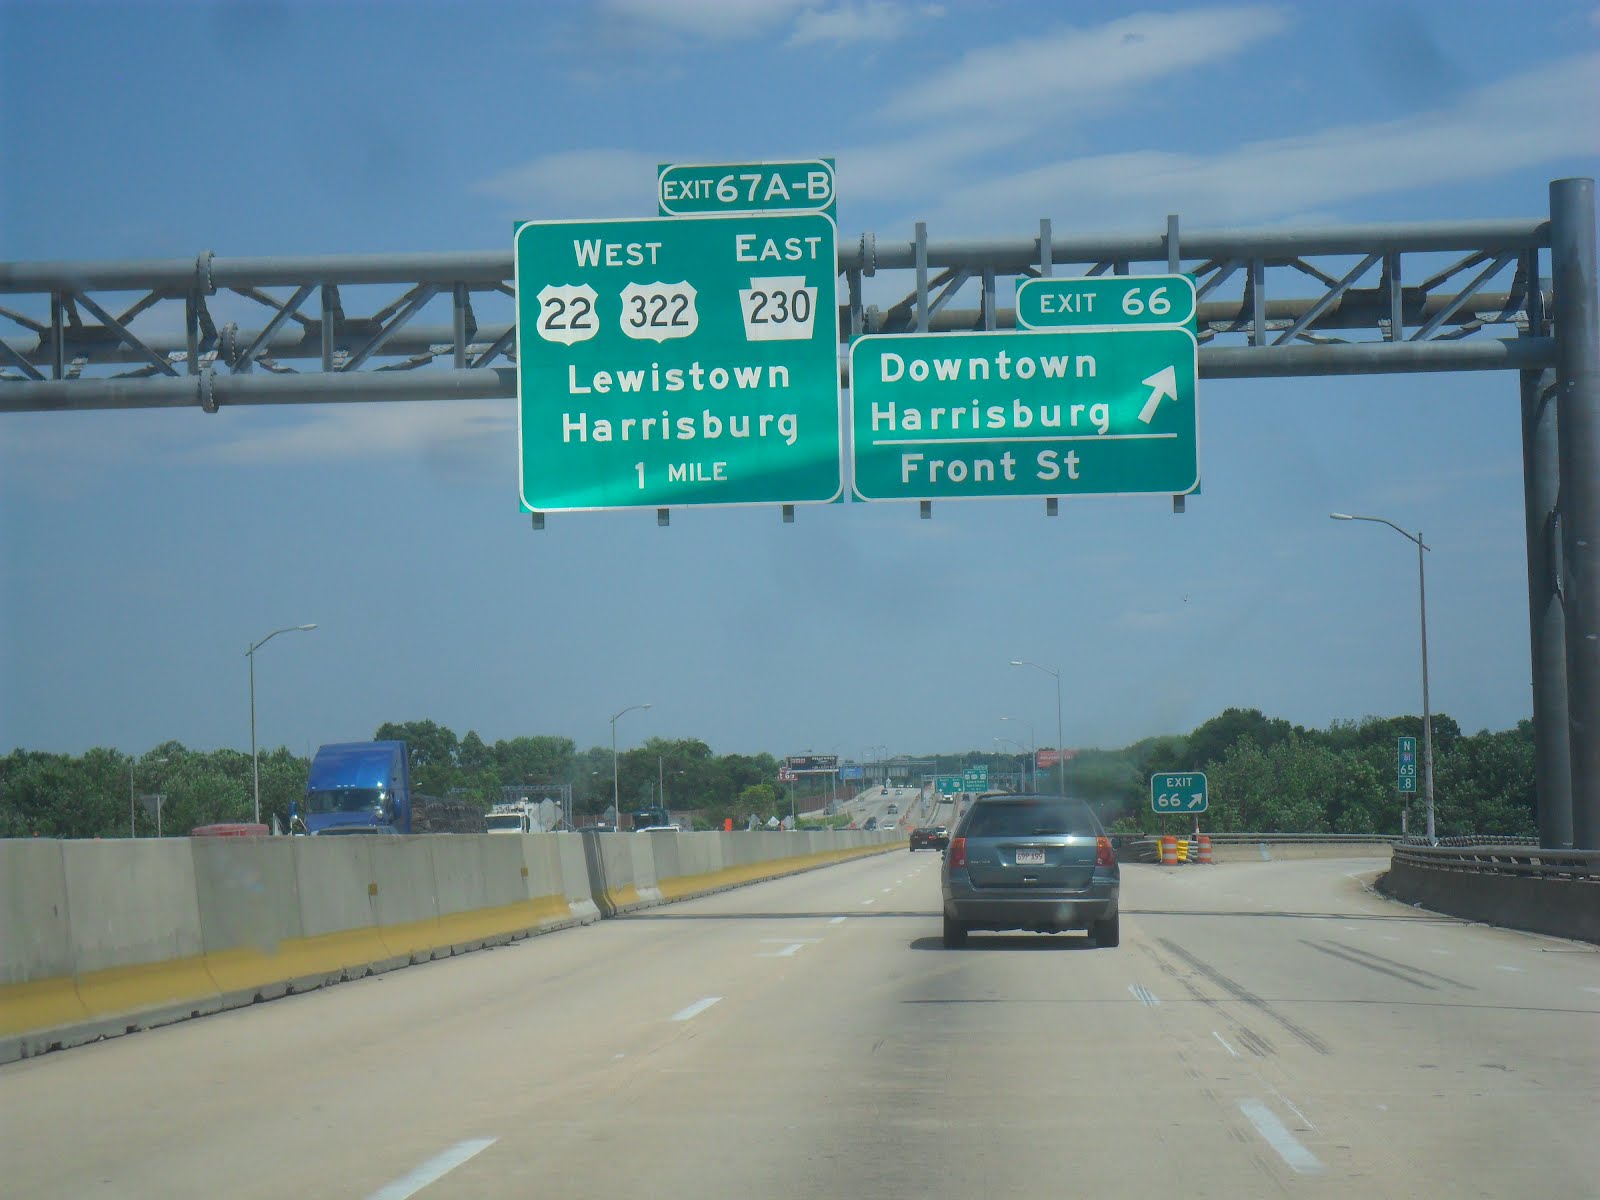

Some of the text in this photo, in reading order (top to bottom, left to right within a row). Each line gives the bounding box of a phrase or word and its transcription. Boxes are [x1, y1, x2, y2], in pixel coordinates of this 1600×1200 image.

[663, 172, 830, 202] EXIT 67A-B
[573, 239, 662, 267] WEST
[735, 234, 821, 262] EAST
[544, 294, 689, 330] 22 322
[749, 290, 811, 324] 230
[1040, 287, 1171, 316] EXIT 66
[568, 361, 789, 394] Lewistown
[881, 351, 1097, 383] Downtown
[562, 409, 798, 446] Harrisburg
[871, 398, 1110, 435] Harrisburg
[635, 461, 728, 489] 1 MILE
[901, 449, 1080, 483] Front St
[1403, 740, 1411, 751] N
[1166, 777, 1193, 788] EXIT
[1400, 764, 1414, 775] 65
[1158, 793, 1181, 807] 66
